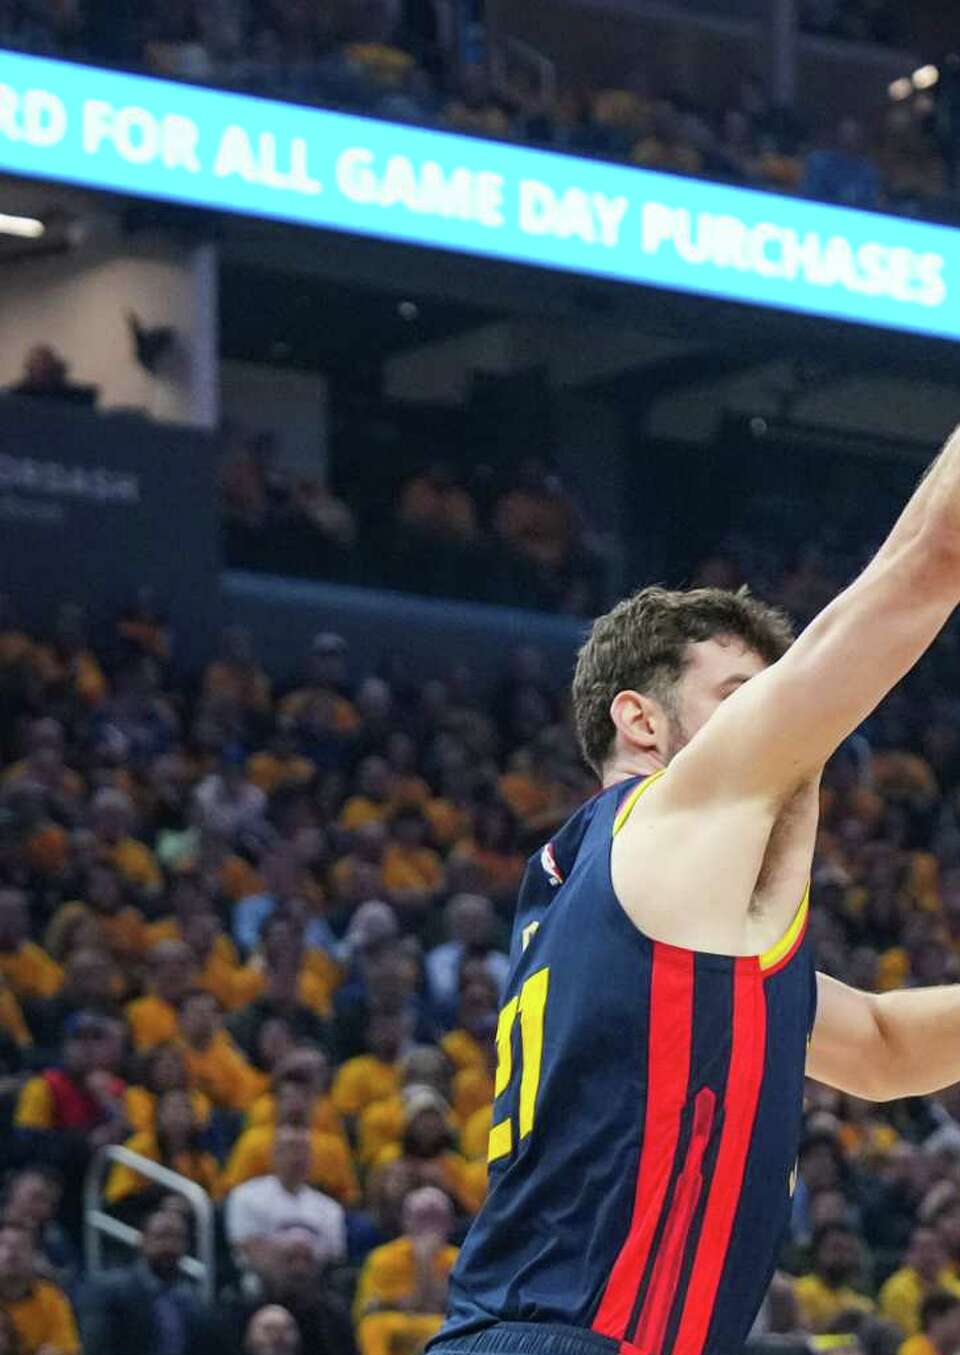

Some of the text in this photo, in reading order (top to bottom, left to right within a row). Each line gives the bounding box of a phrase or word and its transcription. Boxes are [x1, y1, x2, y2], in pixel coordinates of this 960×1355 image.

[82, 99, 200, 173] FOR
[213, 125, 322, 194] ALL
[335, 147, 504, 226] GAME
[519, 179, 627, 246] DAY
[641, 201, 946, 306] PURCHASES
